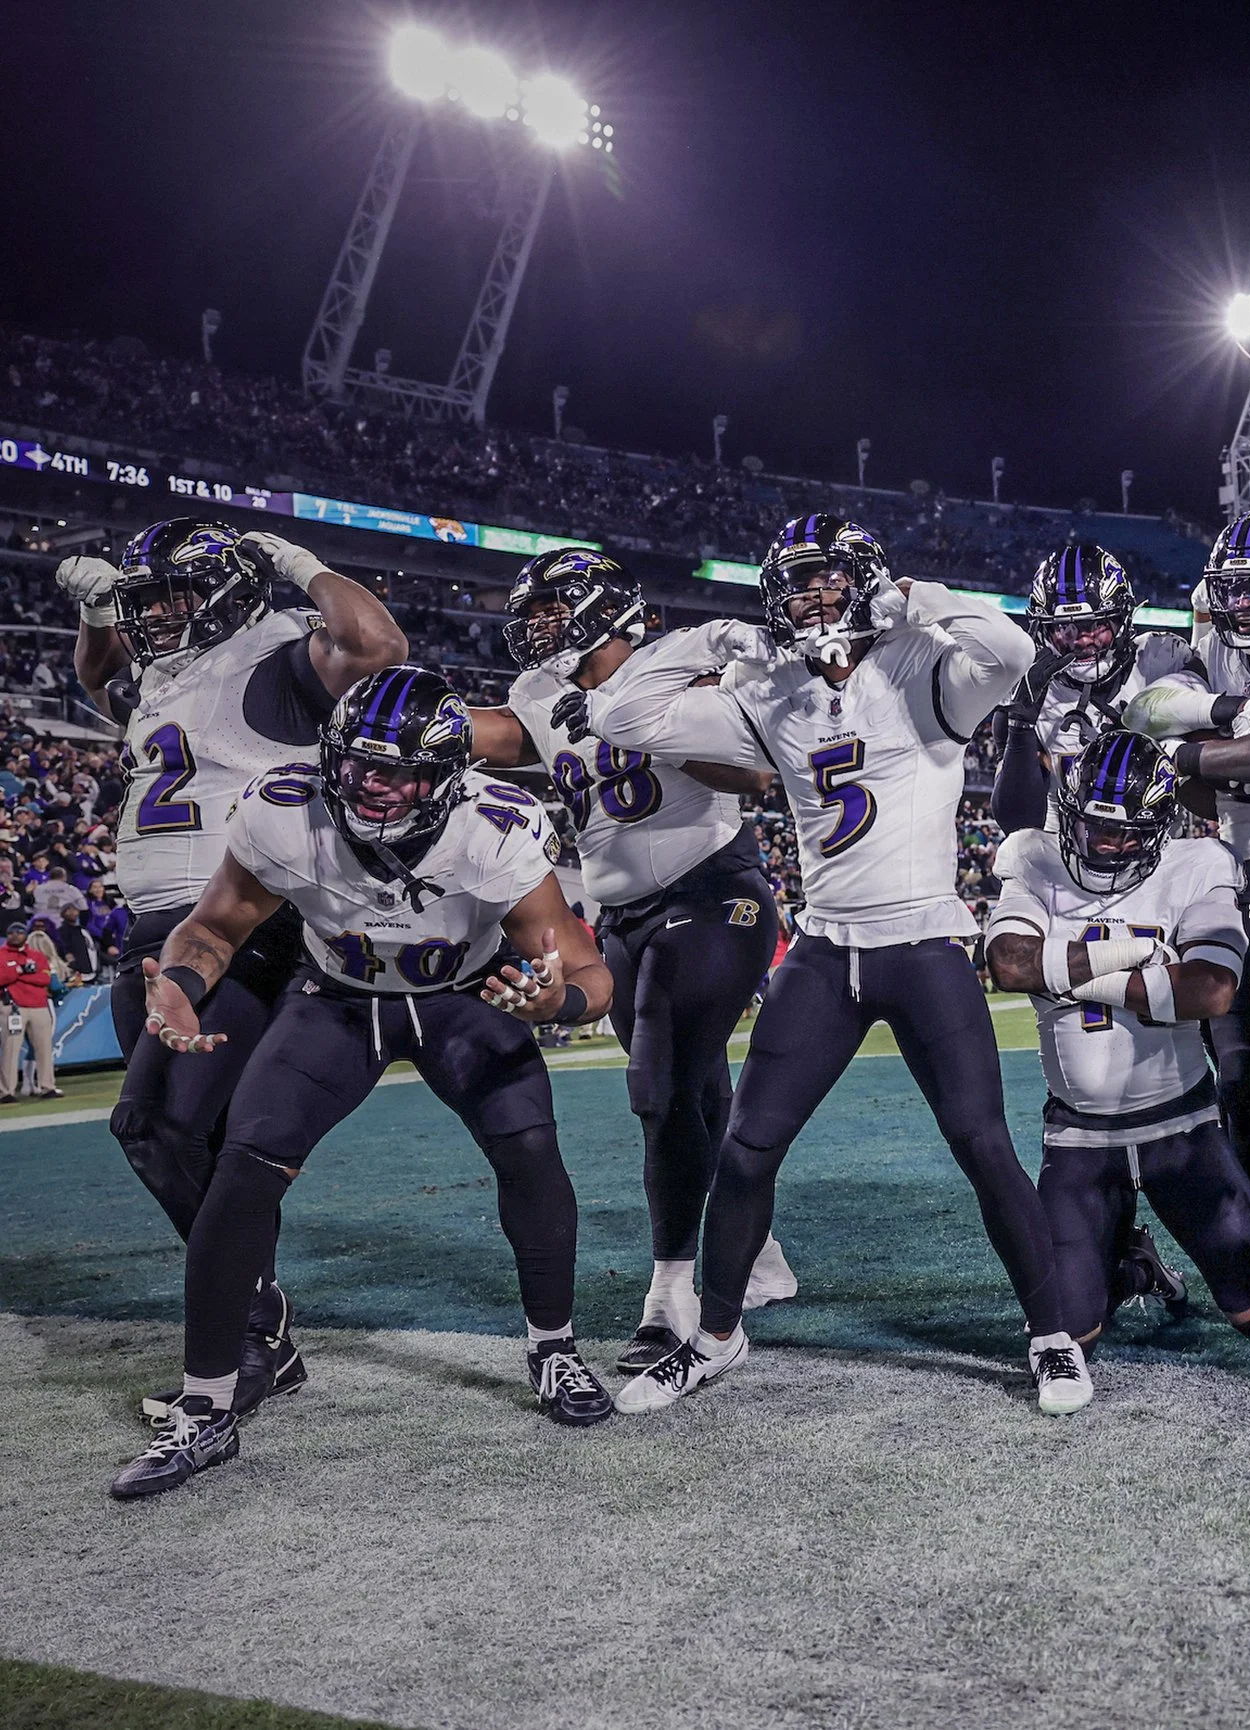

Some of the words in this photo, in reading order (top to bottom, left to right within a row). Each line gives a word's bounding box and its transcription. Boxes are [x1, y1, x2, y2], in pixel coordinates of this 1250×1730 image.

[0, 440, 18, 463] 0
[50, 452, 89, 476] 4TH
[106, 460, 150, 487] 7:36
[168, 475, 195, 496] 1ST
[195, 480, 211, 498] &
[213, 484, 233, 502] 10
[315, 499, 327, 519] 7
[361, 740, 388, 752] RAVENS
[817, 730, 857, 743] RAVENS
[118, 722, 203, 837] 2
[475, 783, 536, 836] 40
[808, 738, 877, 858] 5
[363, 921, 412, 930] RAVENS
[1087, 917, 1126, 925] RAVENS
[326, 930, 471, 987] 40
